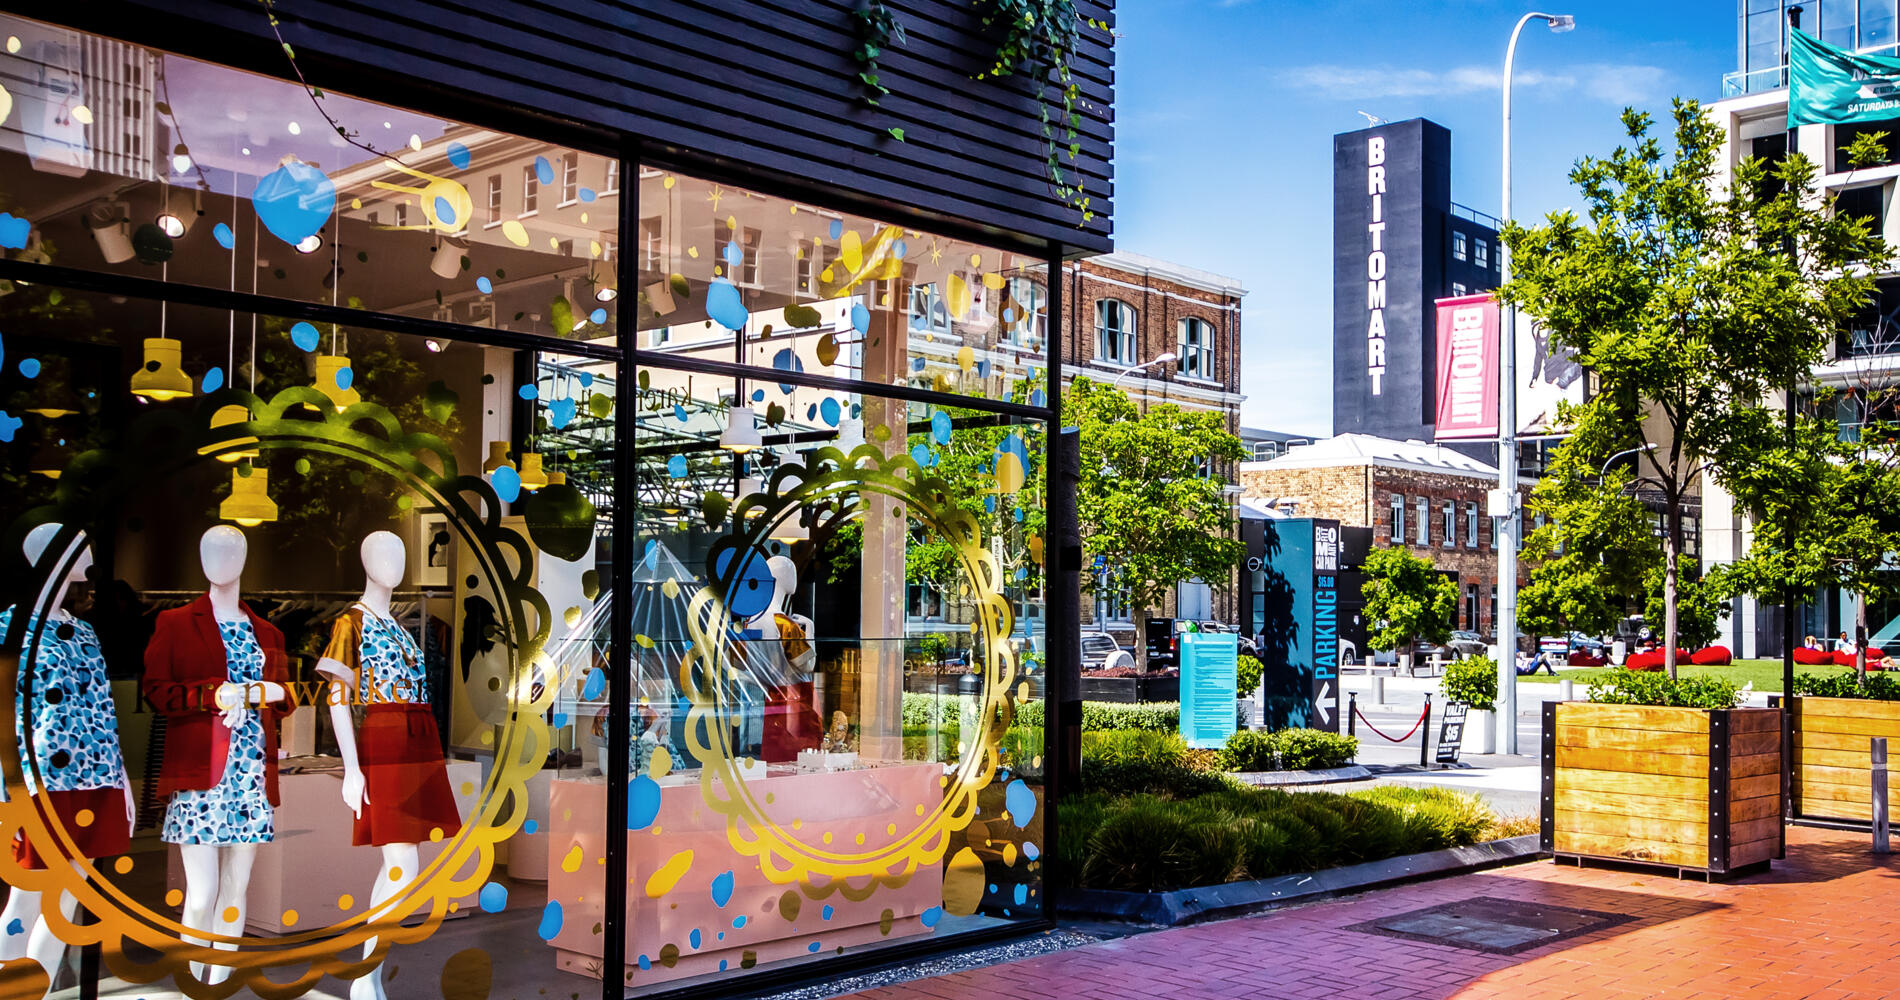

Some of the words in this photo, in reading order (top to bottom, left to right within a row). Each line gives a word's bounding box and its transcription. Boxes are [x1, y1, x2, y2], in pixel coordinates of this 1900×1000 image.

[1847, 100, 1893, 114] SATURDAYS
[1368, 136, 1386, 395] BRITOMART
[1452, 307, 1483, 424] BRITOMART
[1315, 591, 1336, 679] PARKING
[133, 674, 269, 713] karen
[284, 667, 433, 706] walker
